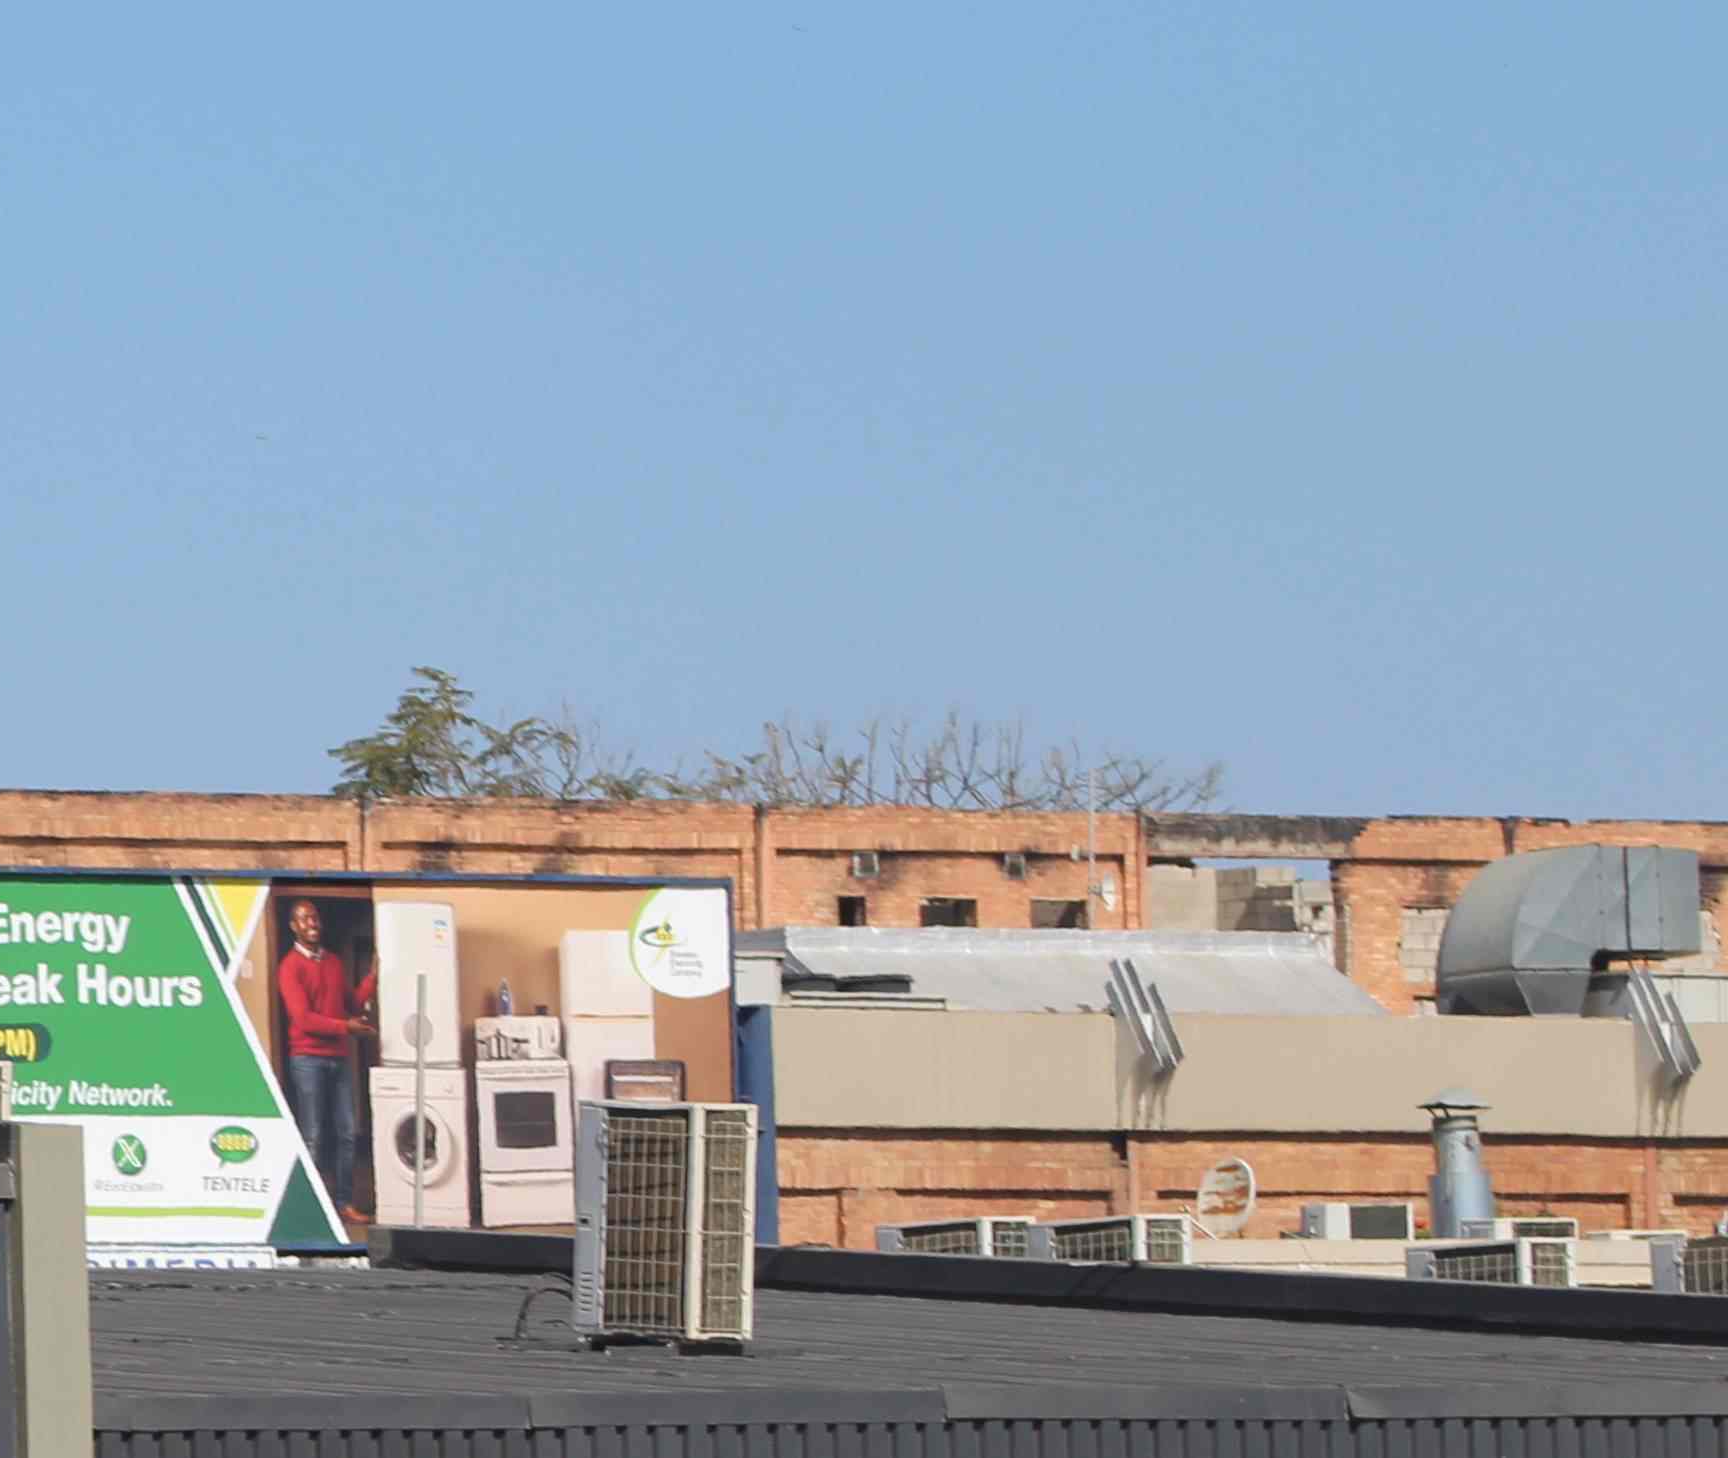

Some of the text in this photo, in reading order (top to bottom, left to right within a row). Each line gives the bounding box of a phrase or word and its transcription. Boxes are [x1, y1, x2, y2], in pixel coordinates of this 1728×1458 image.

[76, 963, 204, 1008] Hours
[68, 1080, 174, 1107] Network.
[202, 1176, 271, 1193] TENTELE
